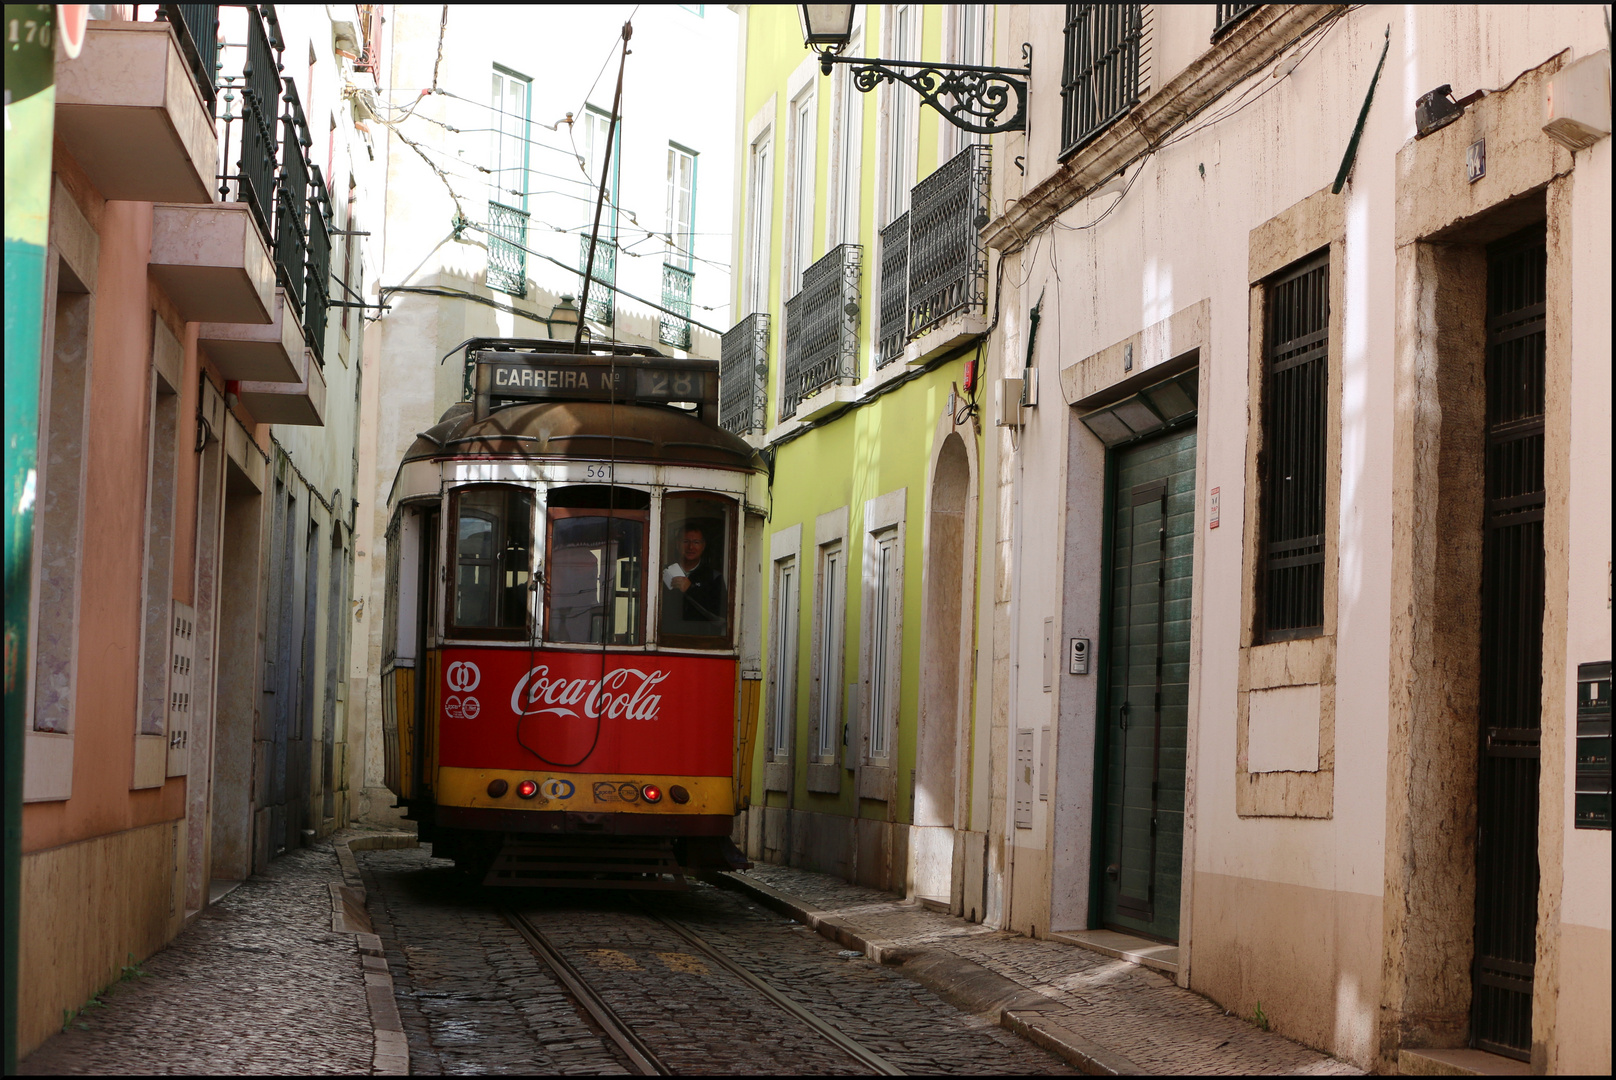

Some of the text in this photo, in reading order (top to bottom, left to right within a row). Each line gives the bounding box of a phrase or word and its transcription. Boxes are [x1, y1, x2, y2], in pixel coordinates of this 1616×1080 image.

[496, 368, 589, 388] CARREIRA
[652, 370, 692, 396] 28
[587, 464, 612, 479] 561
